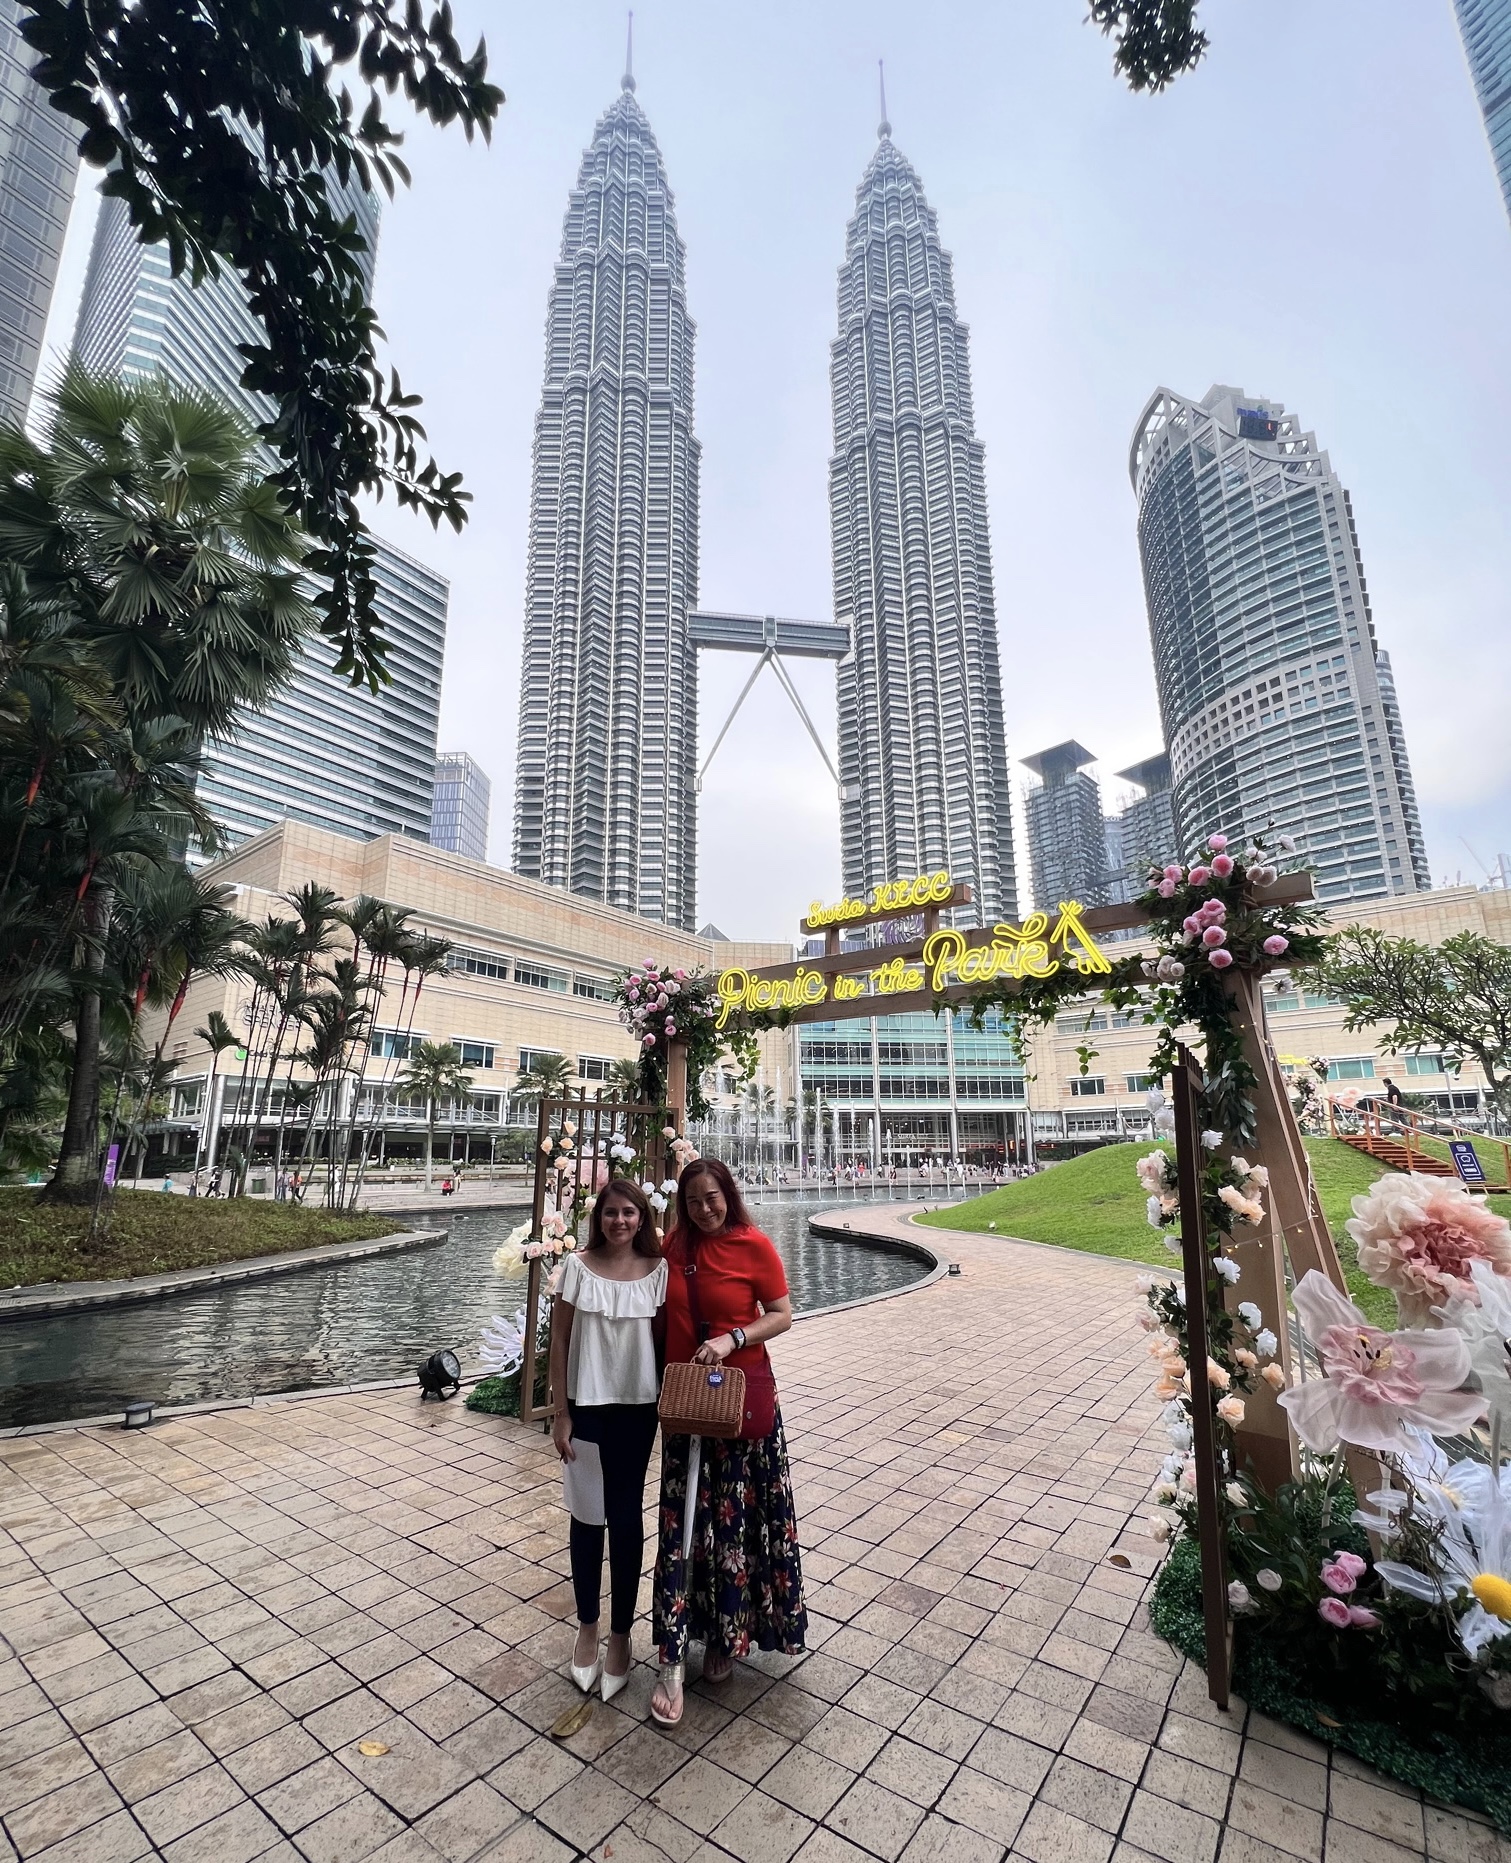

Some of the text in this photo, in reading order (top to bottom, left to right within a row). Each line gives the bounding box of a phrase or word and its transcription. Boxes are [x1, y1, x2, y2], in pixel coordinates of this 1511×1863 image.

[806, 870, 952, 928] Suria KLCC
[715, 912, 1060, 1030] Picnic in the Park
